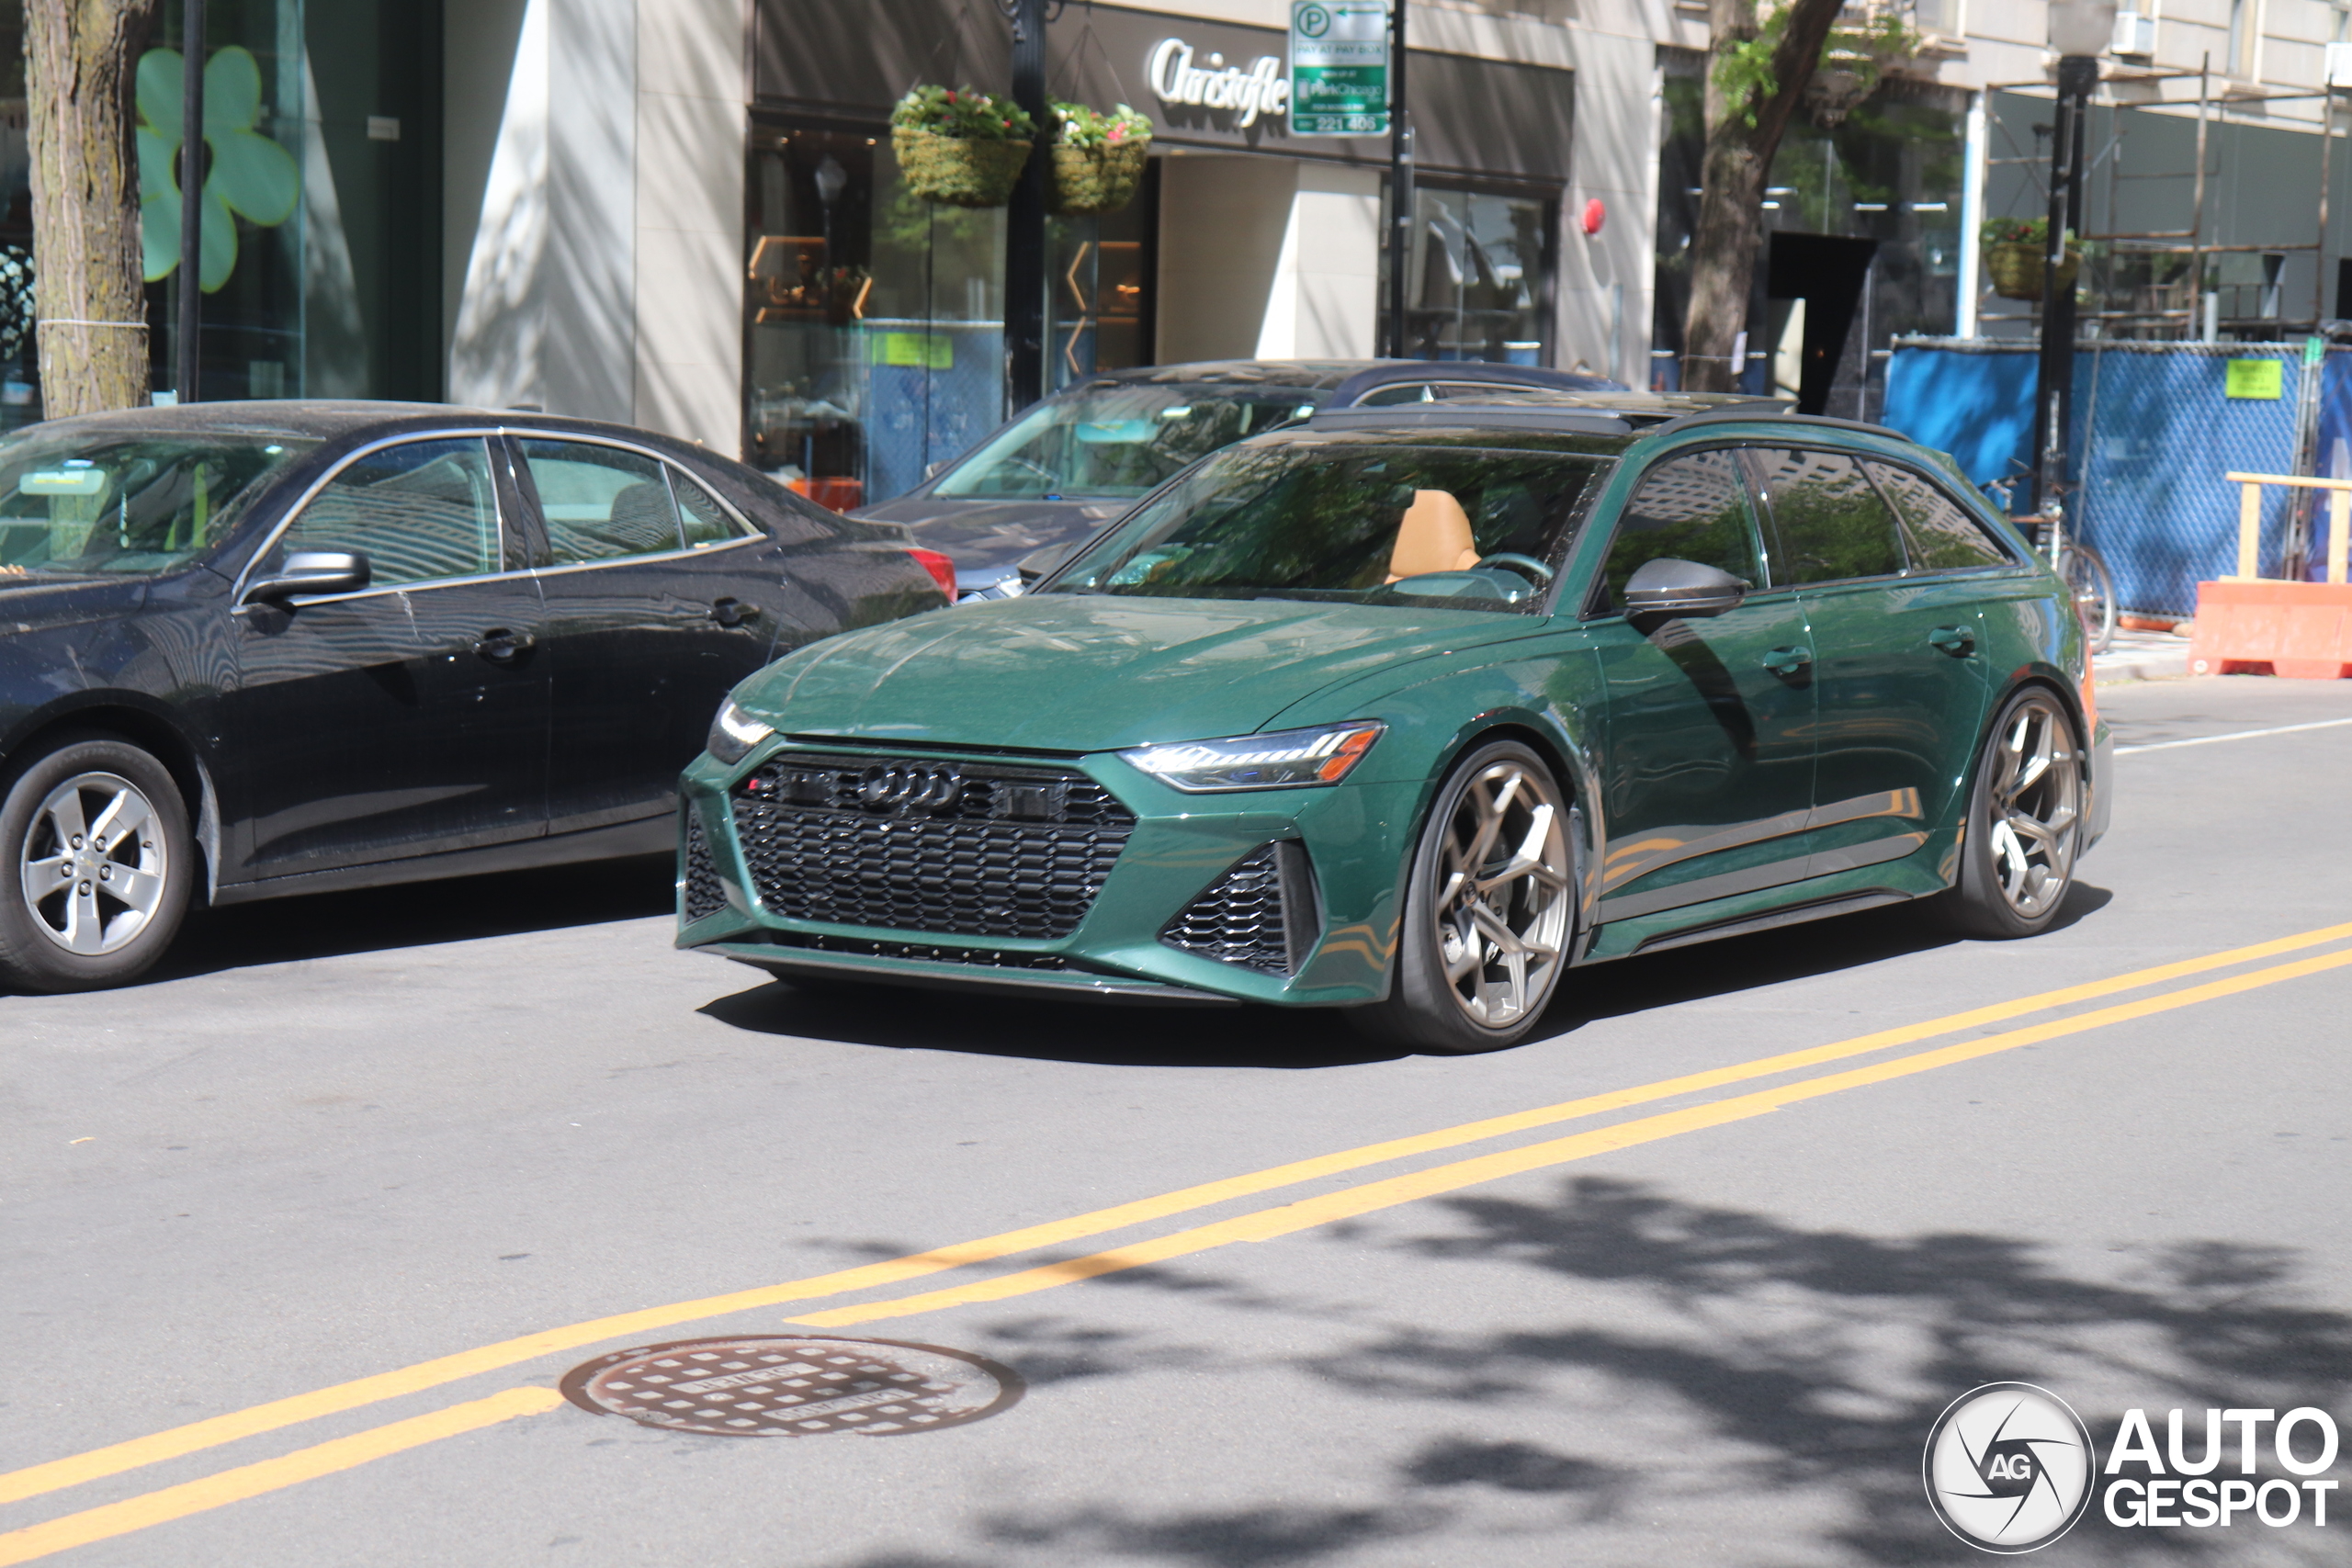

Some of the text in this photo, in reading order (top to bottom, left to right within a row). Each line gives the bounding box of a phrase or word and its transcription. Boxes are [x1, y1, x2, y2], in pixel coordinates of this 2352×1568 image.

[1306, 10, 1323, 31] P
[1297, 45, 1383, 54] PAY AT PAY BOX
[1150, 37, 1291, 128] Christofle
[1310, 82, 1383, 97] ParkChicago
[1317, 117, 1343, 130] 221
[1347, 117, 1376, 130] 406
[694, 1366, 798, 1390] SEWER
[775, 1391, 900, 1419] CHIAGO
